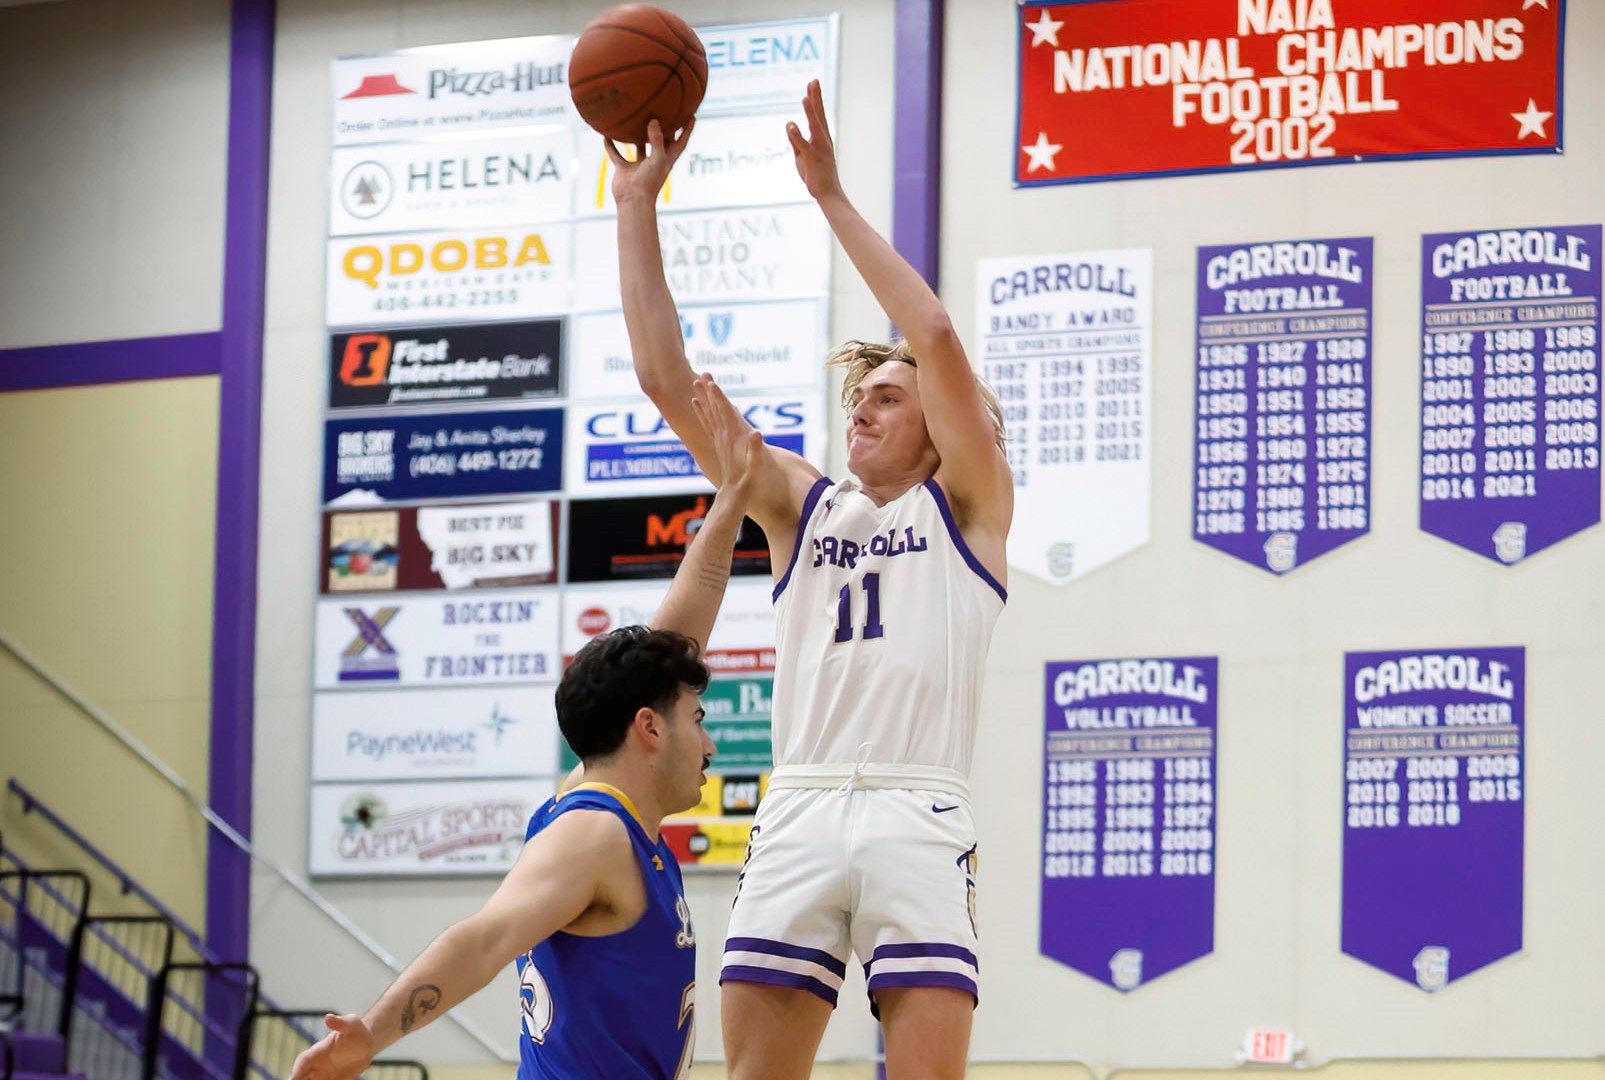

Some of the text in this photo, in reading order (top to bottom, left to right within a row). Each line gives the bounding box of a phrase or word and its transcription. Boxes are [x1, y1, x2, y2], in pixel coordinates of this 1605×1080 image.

[1237, 0, 1335, 36] NAIA
[708, 33, 821, 69] ELENA
[1053, 17, 1525, 94] NATIONAL CHAMPIONS
[427, 61, 566, 100] Pizza Hut
[1172, 69, 1399, 127] FOOTBALL
[1230, 114, 1336, 164] 2002
[407, 152, 563, 192] HELENA
[342, 233, 552, 289] QDOBA
[1206, 242, 1363, 290] CARROLL
[1432, 230, 1592, 279] CARROLL
[386, 274, 486, 292] MEXICAN
[990, 263, 1136, 305] CARROLL
[1224, 284, 1345, 313] FOOTBALL
[1450, 272, 1573, 301] FOOTBALL
[1067, 307, 1135, 326] AWARD
[392, 337, 450, 363] First
[387, 352, 551, 385] Interstate Bank
[1423, 378, 1473, 400] 2001
[1484, 400, 1536, 423] 2005
[589, 456, 689, 479] PLUMBING
[1422, 452, 1476, 475] 2010
[1484, 450, 1536, 472] 2011
[447, 543, 538, 565] BIG SKY
[834, 572, 884, 643] 11
[425, 653, 548, 678] FRONTIER
[1354, 655, 1514, 702] CARROLL
[1054, 659, 1208, 706] CARROLL
[1064, 705, 1197, 729] VOLLEYBALL
[1356, 702, 1512, 728] WOMEN'S SOCCER
[347, 729, 477, 761] PayneWest
[1252, 1031, 1288, 1063] EXIT
